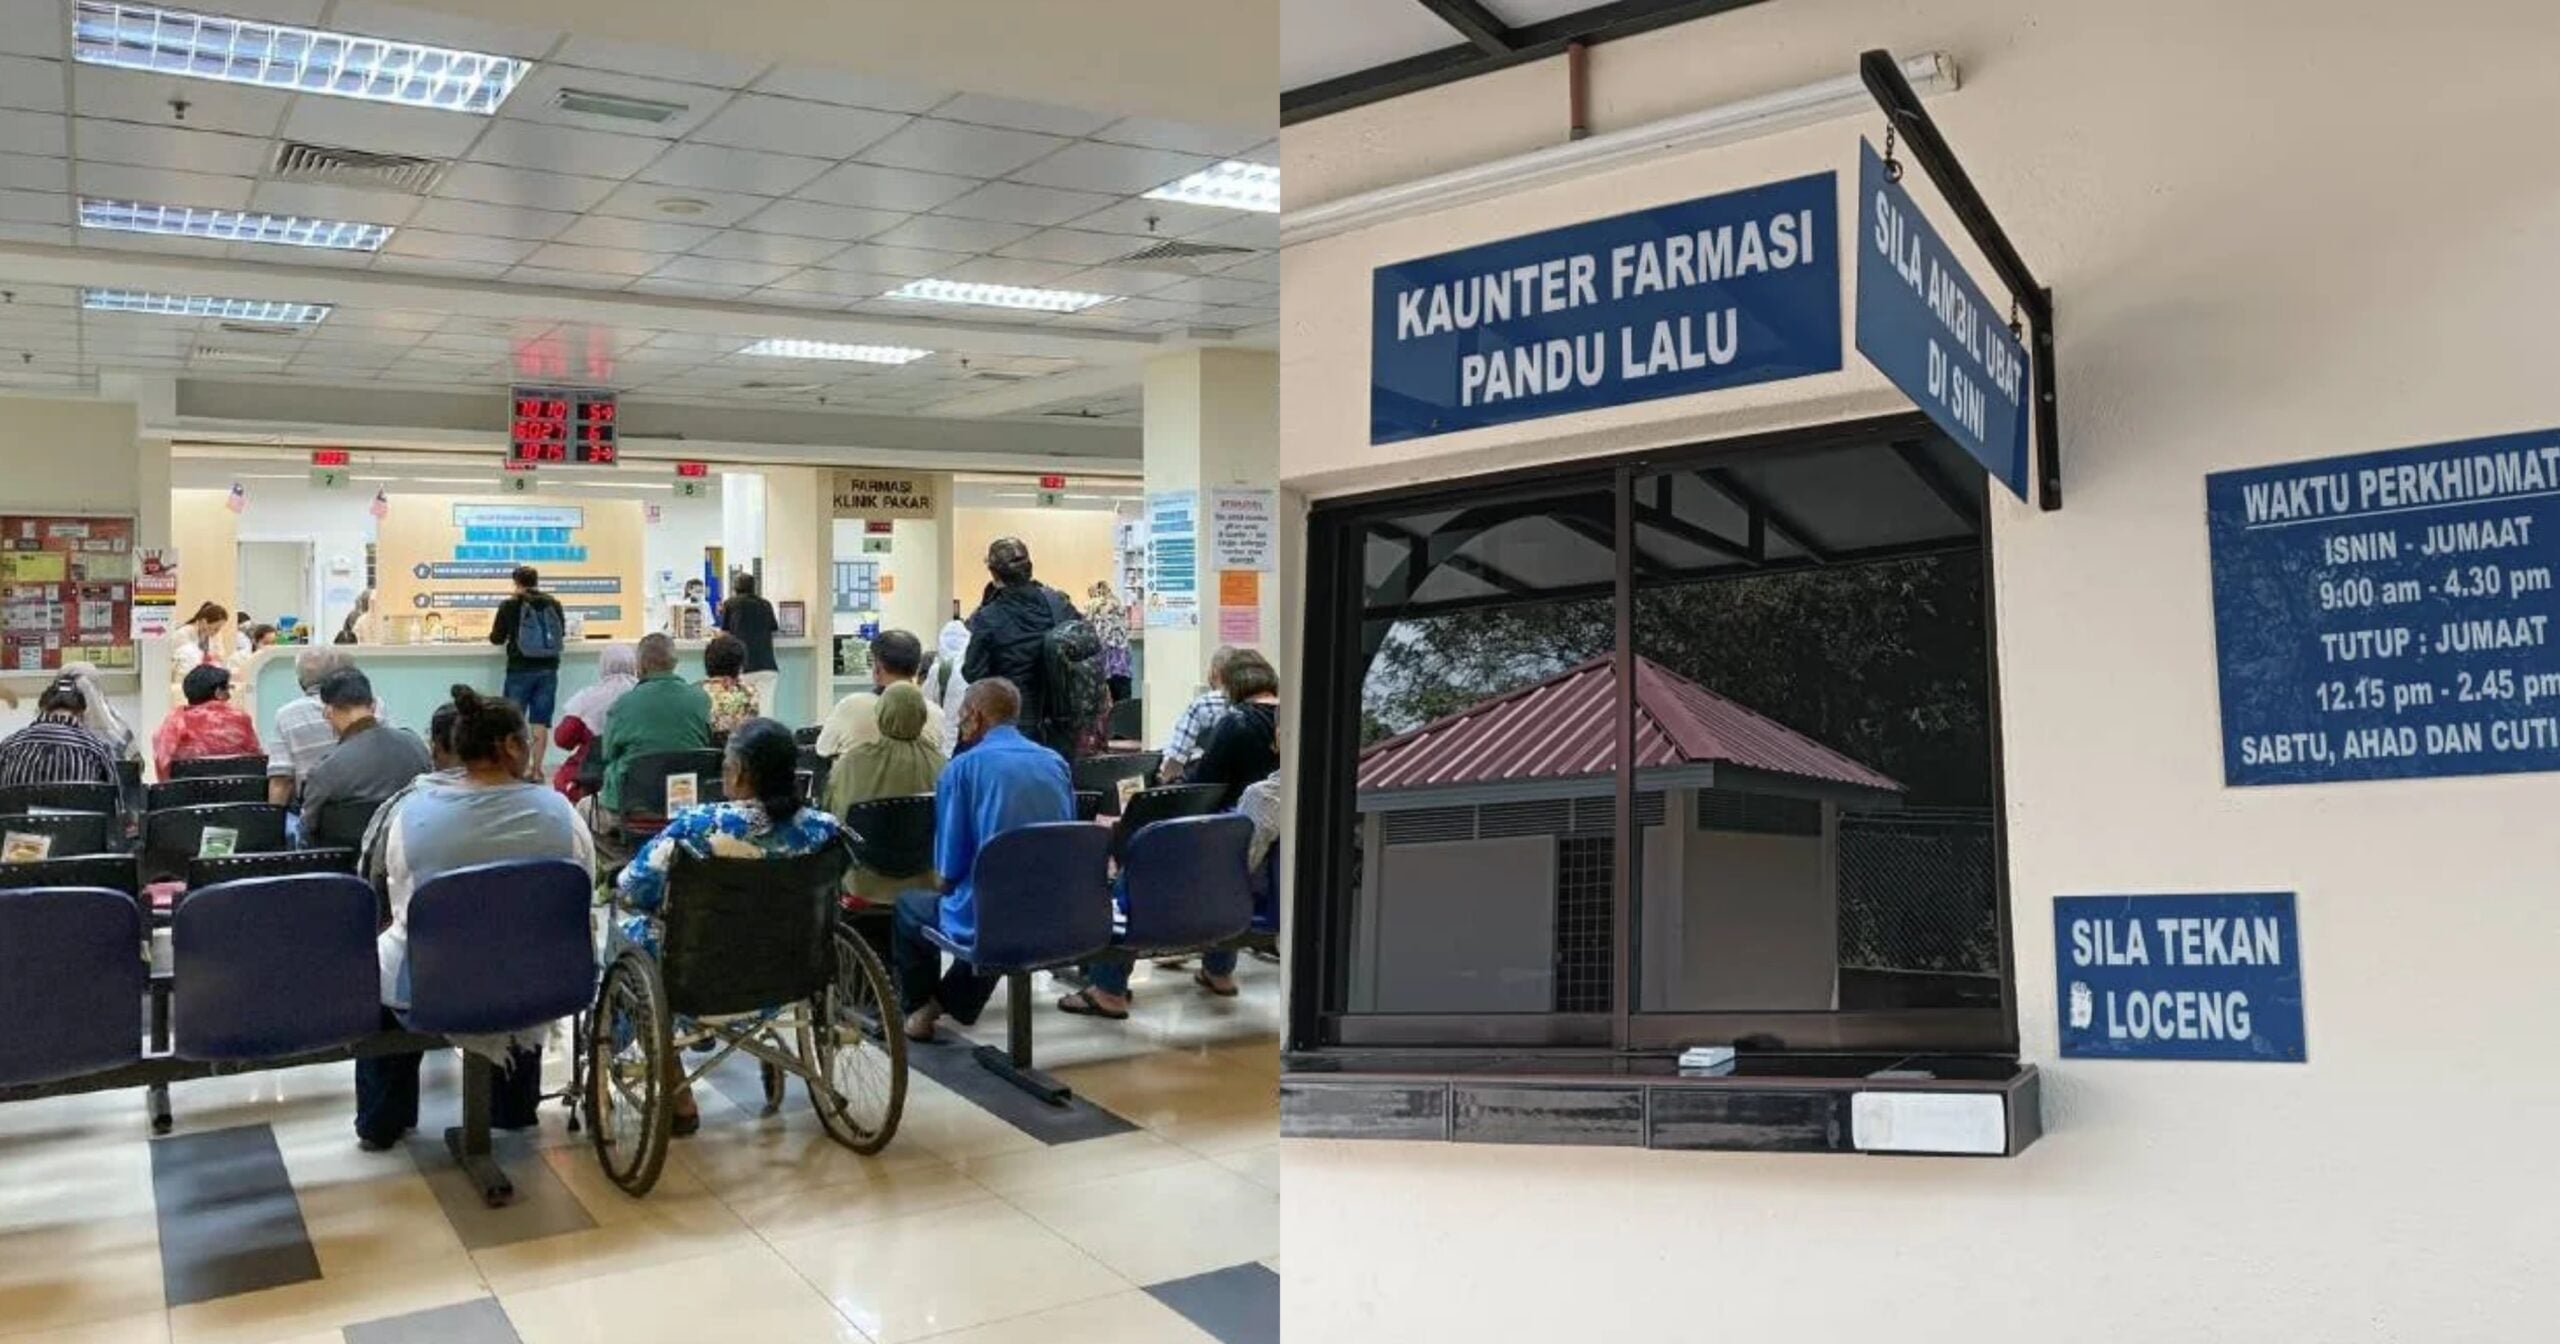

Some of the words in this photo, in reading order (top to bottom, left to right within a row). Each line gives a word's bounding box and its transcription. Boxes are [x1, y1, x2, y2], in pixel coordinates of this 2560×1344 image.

[1397, 253, 1598, 340] KAUNTER
[1612, 210, 1814, 299] FARMASI
[1875, 190, 1922, 297] SILA
[1928, 258, 1982, 364] AMBIL
[1986, 324, 2022, 407] UBAT
[1462, 332, 1604, 407] PANDU
[1621, 308, 1737, 379] LALU
[1928, 338, 1947, 406] DI
[1951, 364, 1985, 442] SINI
[325, 474, 334, 486] 7
[833, 494, 878, 509] KLINIK
[882, 495, 931, 509] PAKAR
[851, 479, 913, 494] FARMASI
[2243, 473, 2349, 522] WAKTU
[2325, 531, 2397, 566] ISNIN
[2405, 541, 2413, 550] -
[2421, 516, 2532, 556] JUMAAT
[2320, 577, 2373, 609] 9:00
[2383, 580, 2421, 604] am
[2444, 565, 2500, 597] 4.30
[2510, 567, 2551, 599] pm
[2321, 627, 2410, 662] TUTUP
[2435, 615, 2547, 654] JUMAAT
[2316, 678, 2385, 711] 12.15
[2394, 681, 2433, 714] pm
[2457, 669, 2514, 702] 2.45
[2524, 672, 2560, 704] pm
[2241, 733, 2335, 767] SABTU,
[2344, 727, 2417, 760] AHAD
[2426, 723, 2481, 755] DAN
[2491, 717, 2558, 750] CUTI
[2072, 918, 2149, 966] SILA
[2157, 917, 2281, 966] TEKAN
[2107, 990, 2251, 1041] LOCENG
